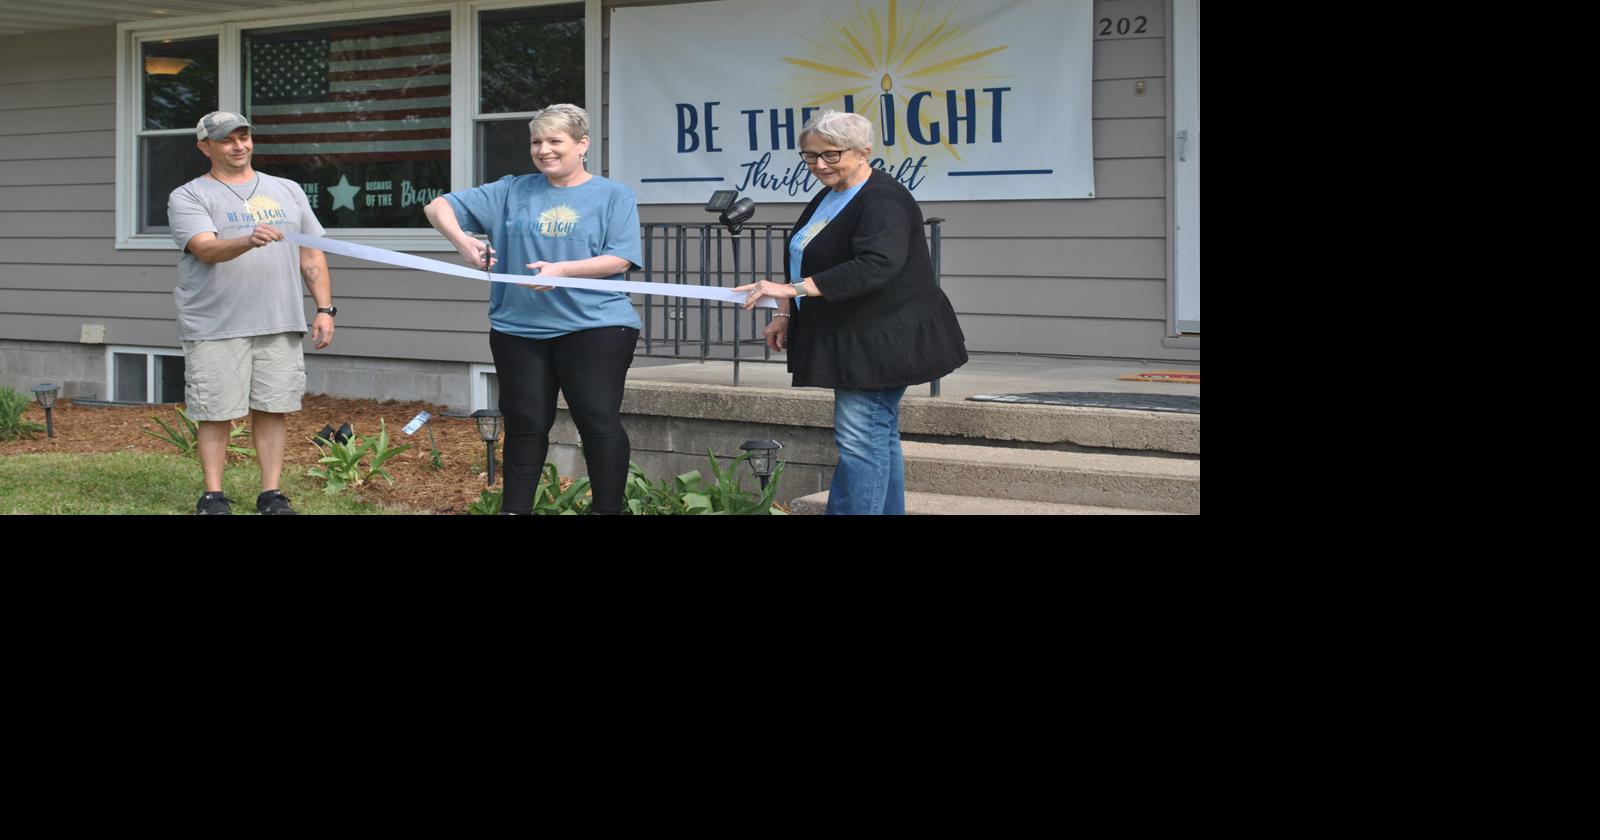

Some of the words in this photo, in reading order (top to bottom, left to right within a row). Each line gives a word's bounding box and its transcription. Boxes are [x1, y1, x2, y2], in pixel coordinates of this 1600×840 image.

[1098, 15, 1148, 36] 202
[675, 101, 723, 153] BE
[365, 181, 392, 191] BECAUSE
[365, 194, 375, 207] OF
[378, 194, 392, 207] THE
[547, 221, 578, 232] LIGHT
